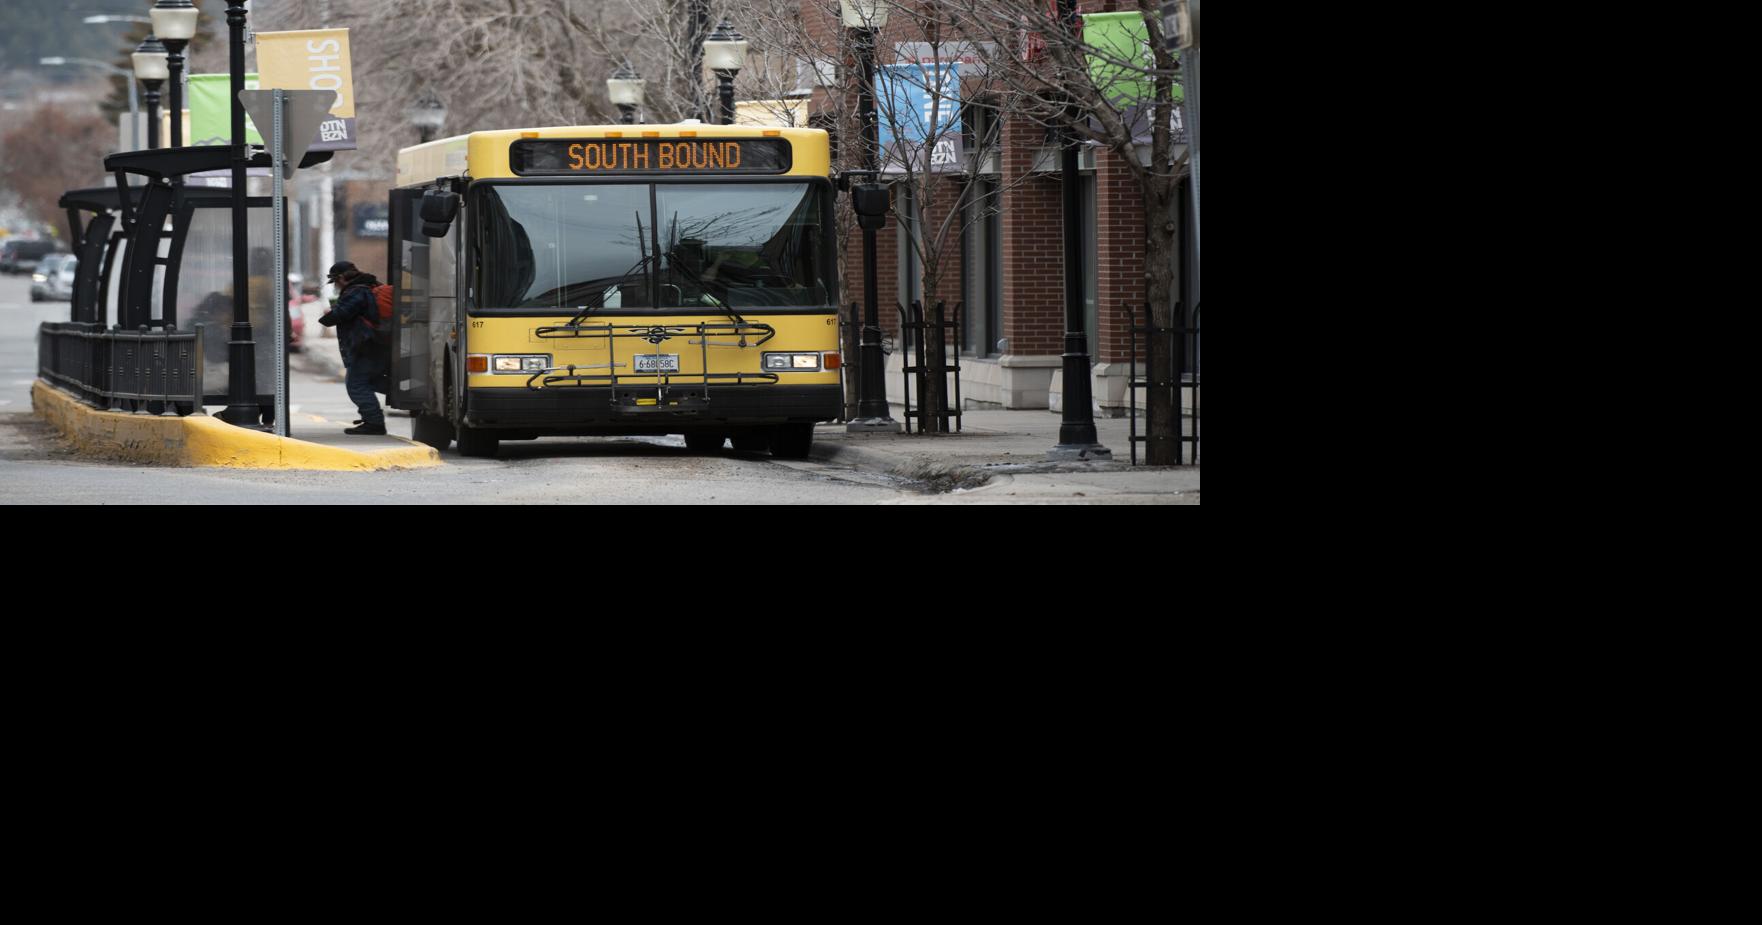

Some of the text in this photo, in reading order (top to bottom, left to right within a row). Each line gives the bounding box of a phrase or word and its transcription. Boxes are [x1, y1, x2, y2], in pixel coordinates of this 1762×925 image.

[306, 39, 344, 109] SHO
[568, 142, 741, 170] SOUTH BOUND
